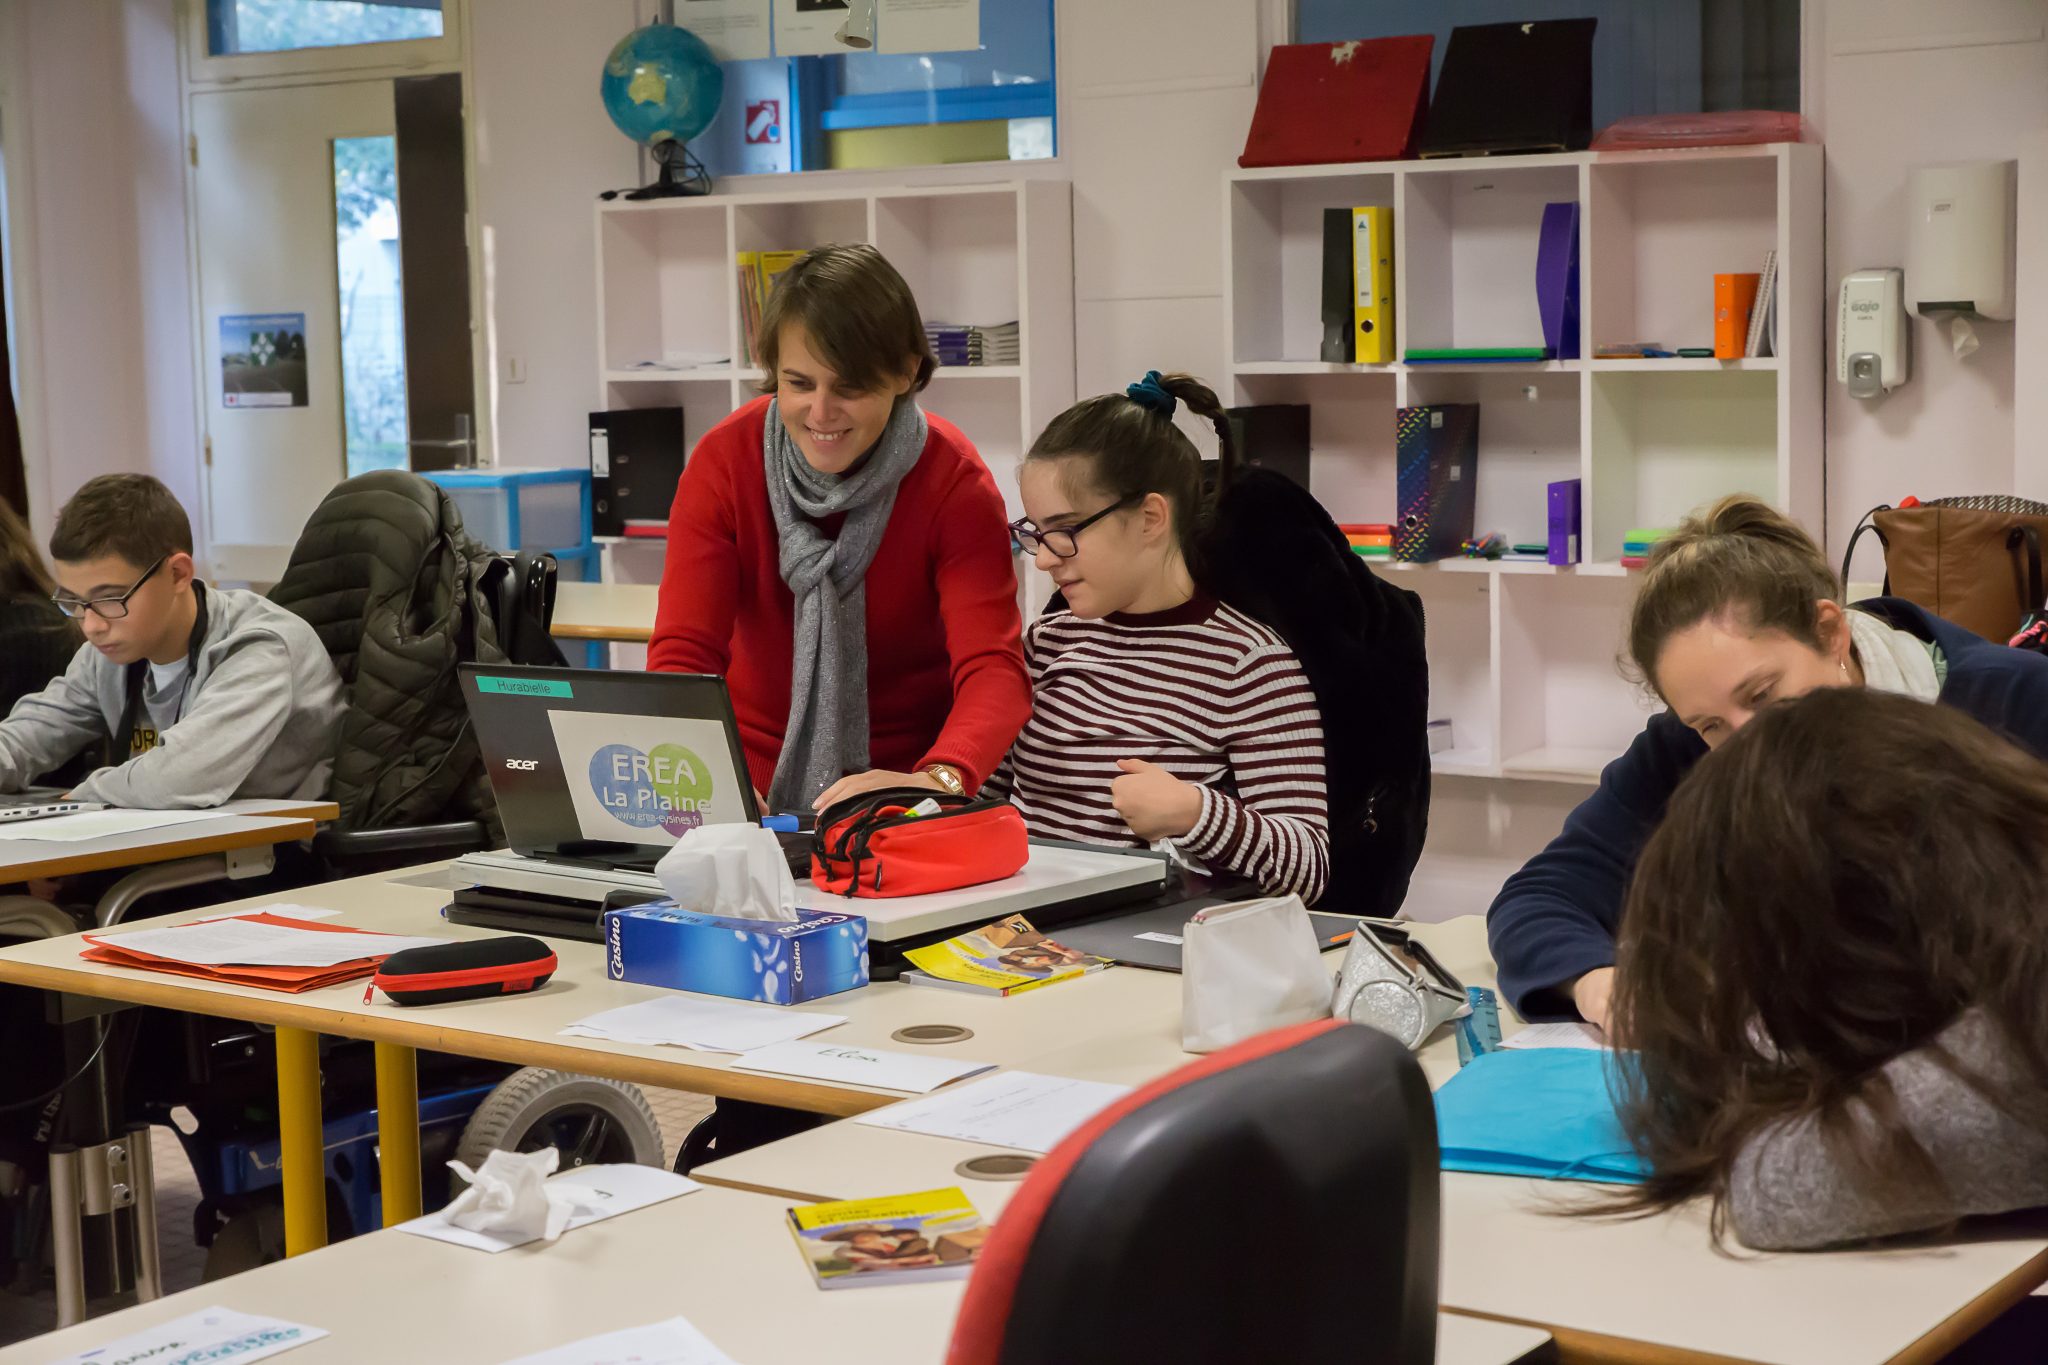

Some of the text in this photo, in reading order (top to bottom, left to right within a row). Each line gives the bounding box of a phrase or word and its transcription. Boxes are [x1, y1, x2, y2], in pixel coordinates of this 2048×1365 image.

[497, 680, 551, 694] Hurabielle
[505, 758, 539, 771] acer
[612, 753, 697, 786] EREA
[603, 786, 712, 814] La Plaine
[615, 811, 700, 825] www.erea-eysines.fr
[777, 914, 848, 935] Casino
[609, 916, 624, 980] Casino
[793, 941, 804, 982] Casino
